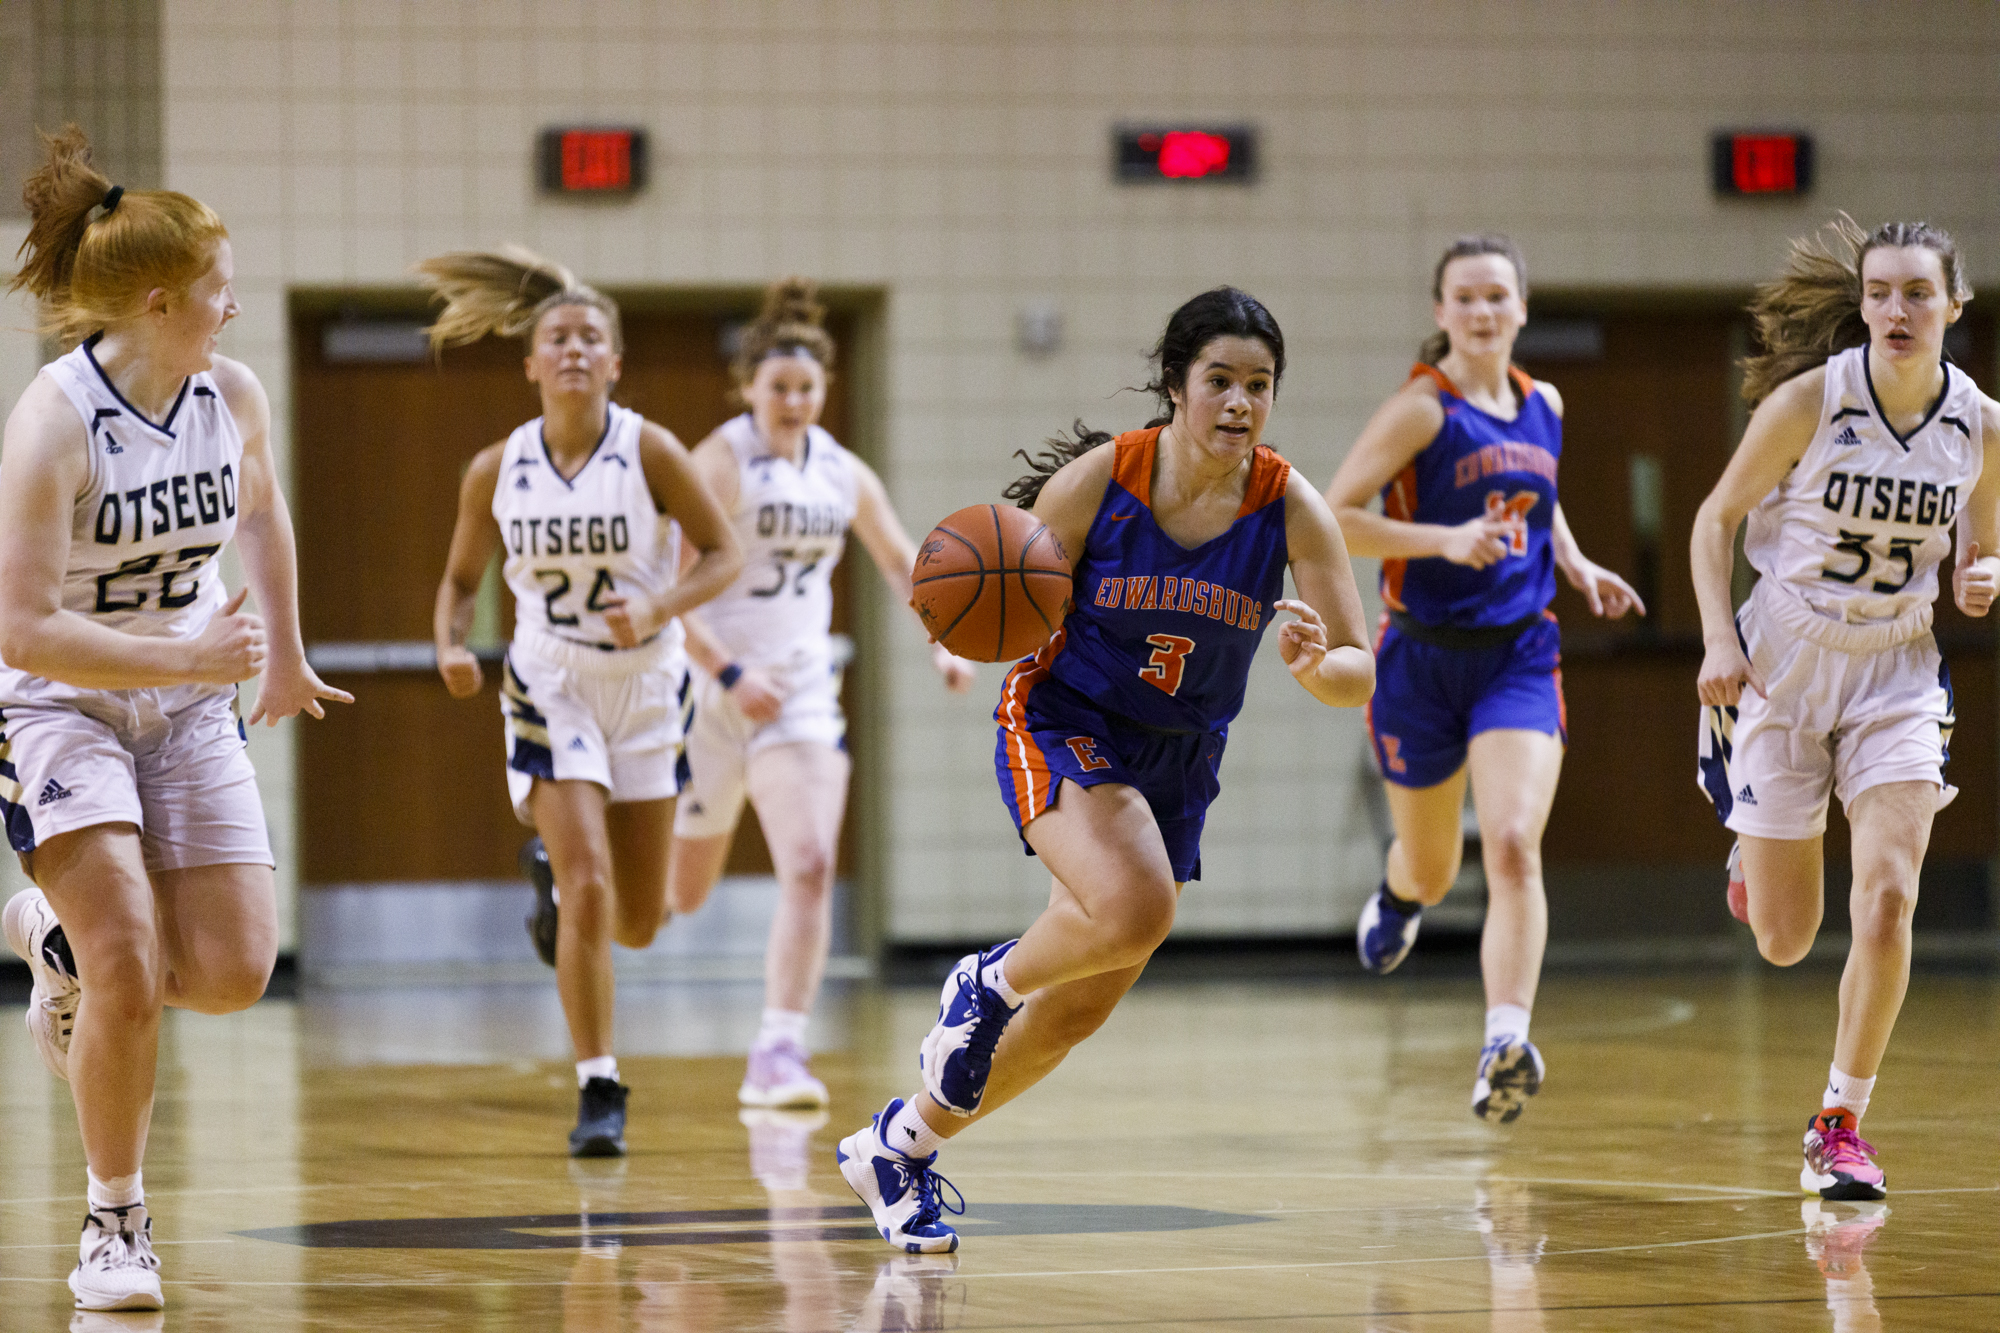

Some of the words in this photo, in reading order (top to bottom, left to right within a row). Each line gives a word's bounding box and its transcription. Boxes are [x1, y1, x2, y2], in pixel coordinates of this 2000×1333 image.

[95, 463, 237, 545] OTSEGO
[1823, 472, 1957, 527] OTSEGO
[510, 515, 629, 556] OTSEGO
[533, 568, 627, 627] 24
[1094, 575, 1262, 631] EDWARDSBURG
[1138, 633, 1196, 697] 3
[1065, 736, 1112, 772] E
